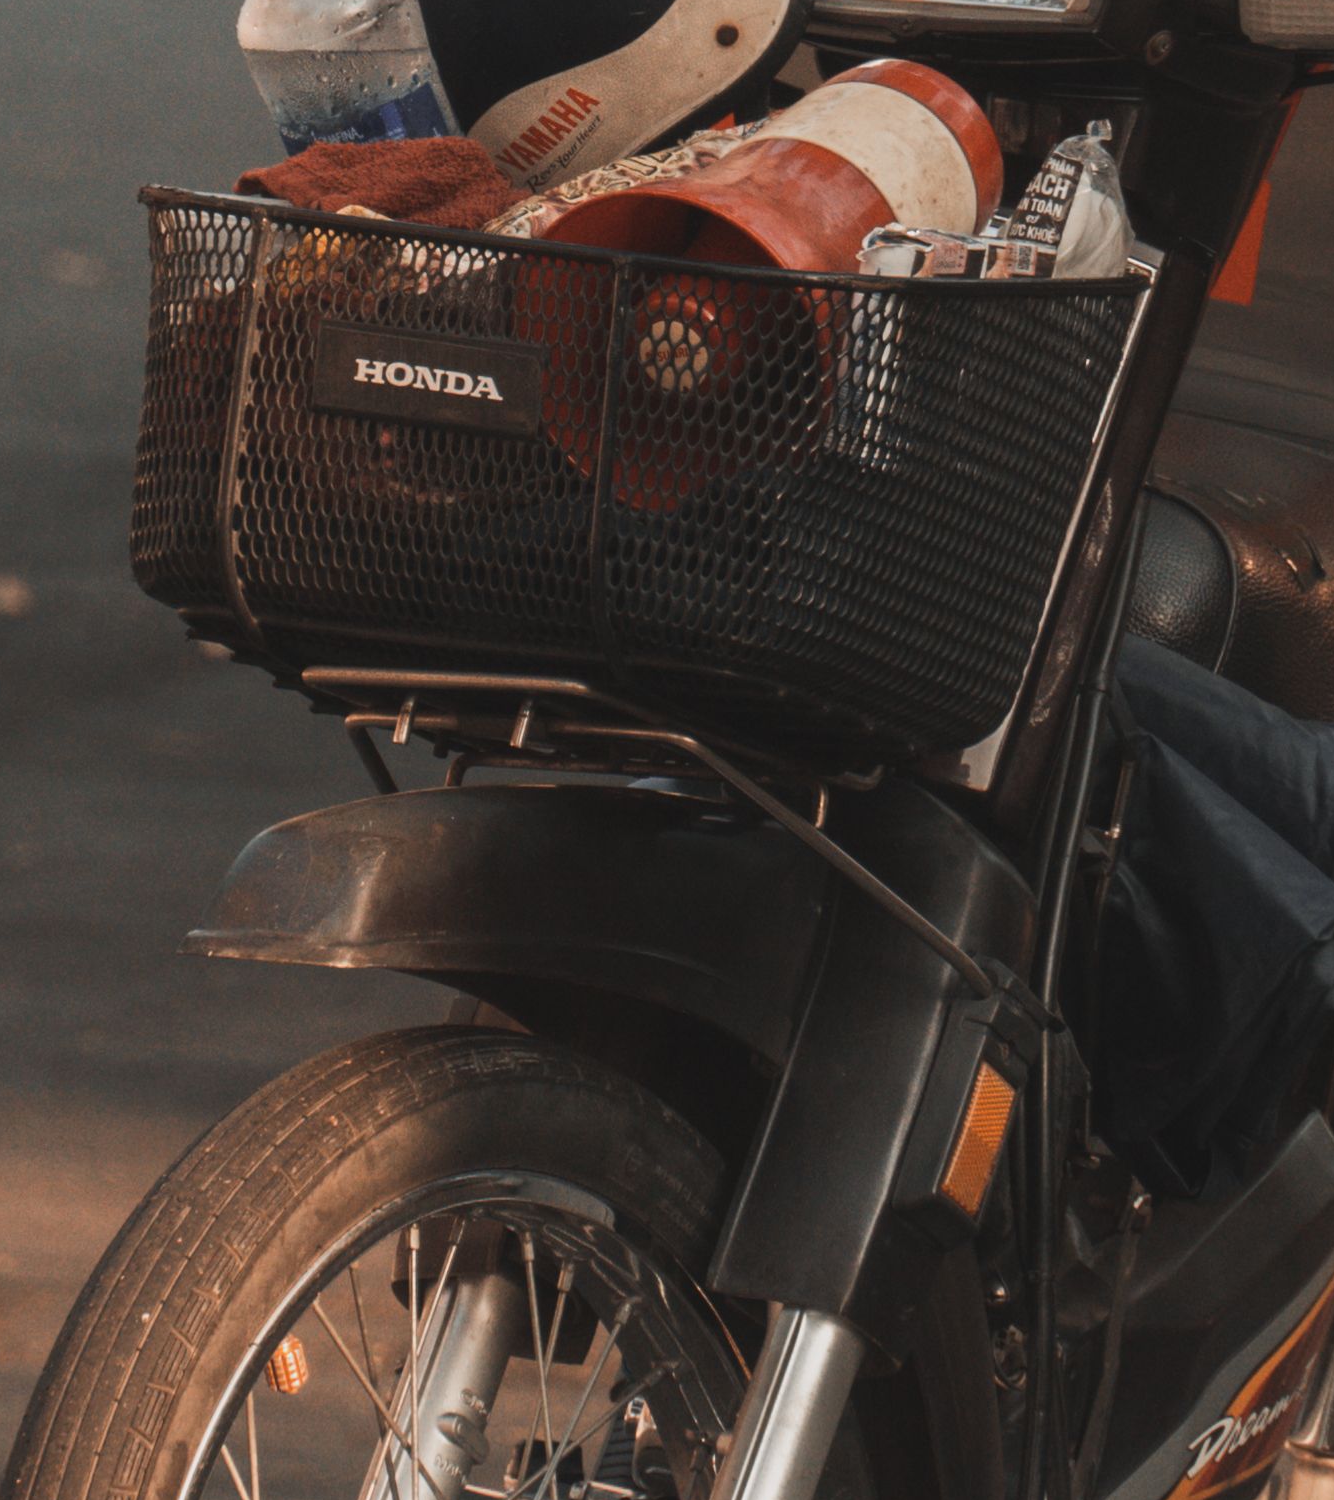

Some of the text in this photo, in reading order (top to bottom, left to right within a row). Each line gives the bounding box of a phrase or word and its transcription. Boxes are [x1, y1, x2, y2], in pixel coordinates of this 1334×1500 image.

[496, 87, 601, 172] YAMAHA
[556, 140, 578, 169] Your
[577, 114, 603, 145] Heart
[353, 358, 504, 401] HONDA
[1187, 1394, 1293, 1479] Dream
